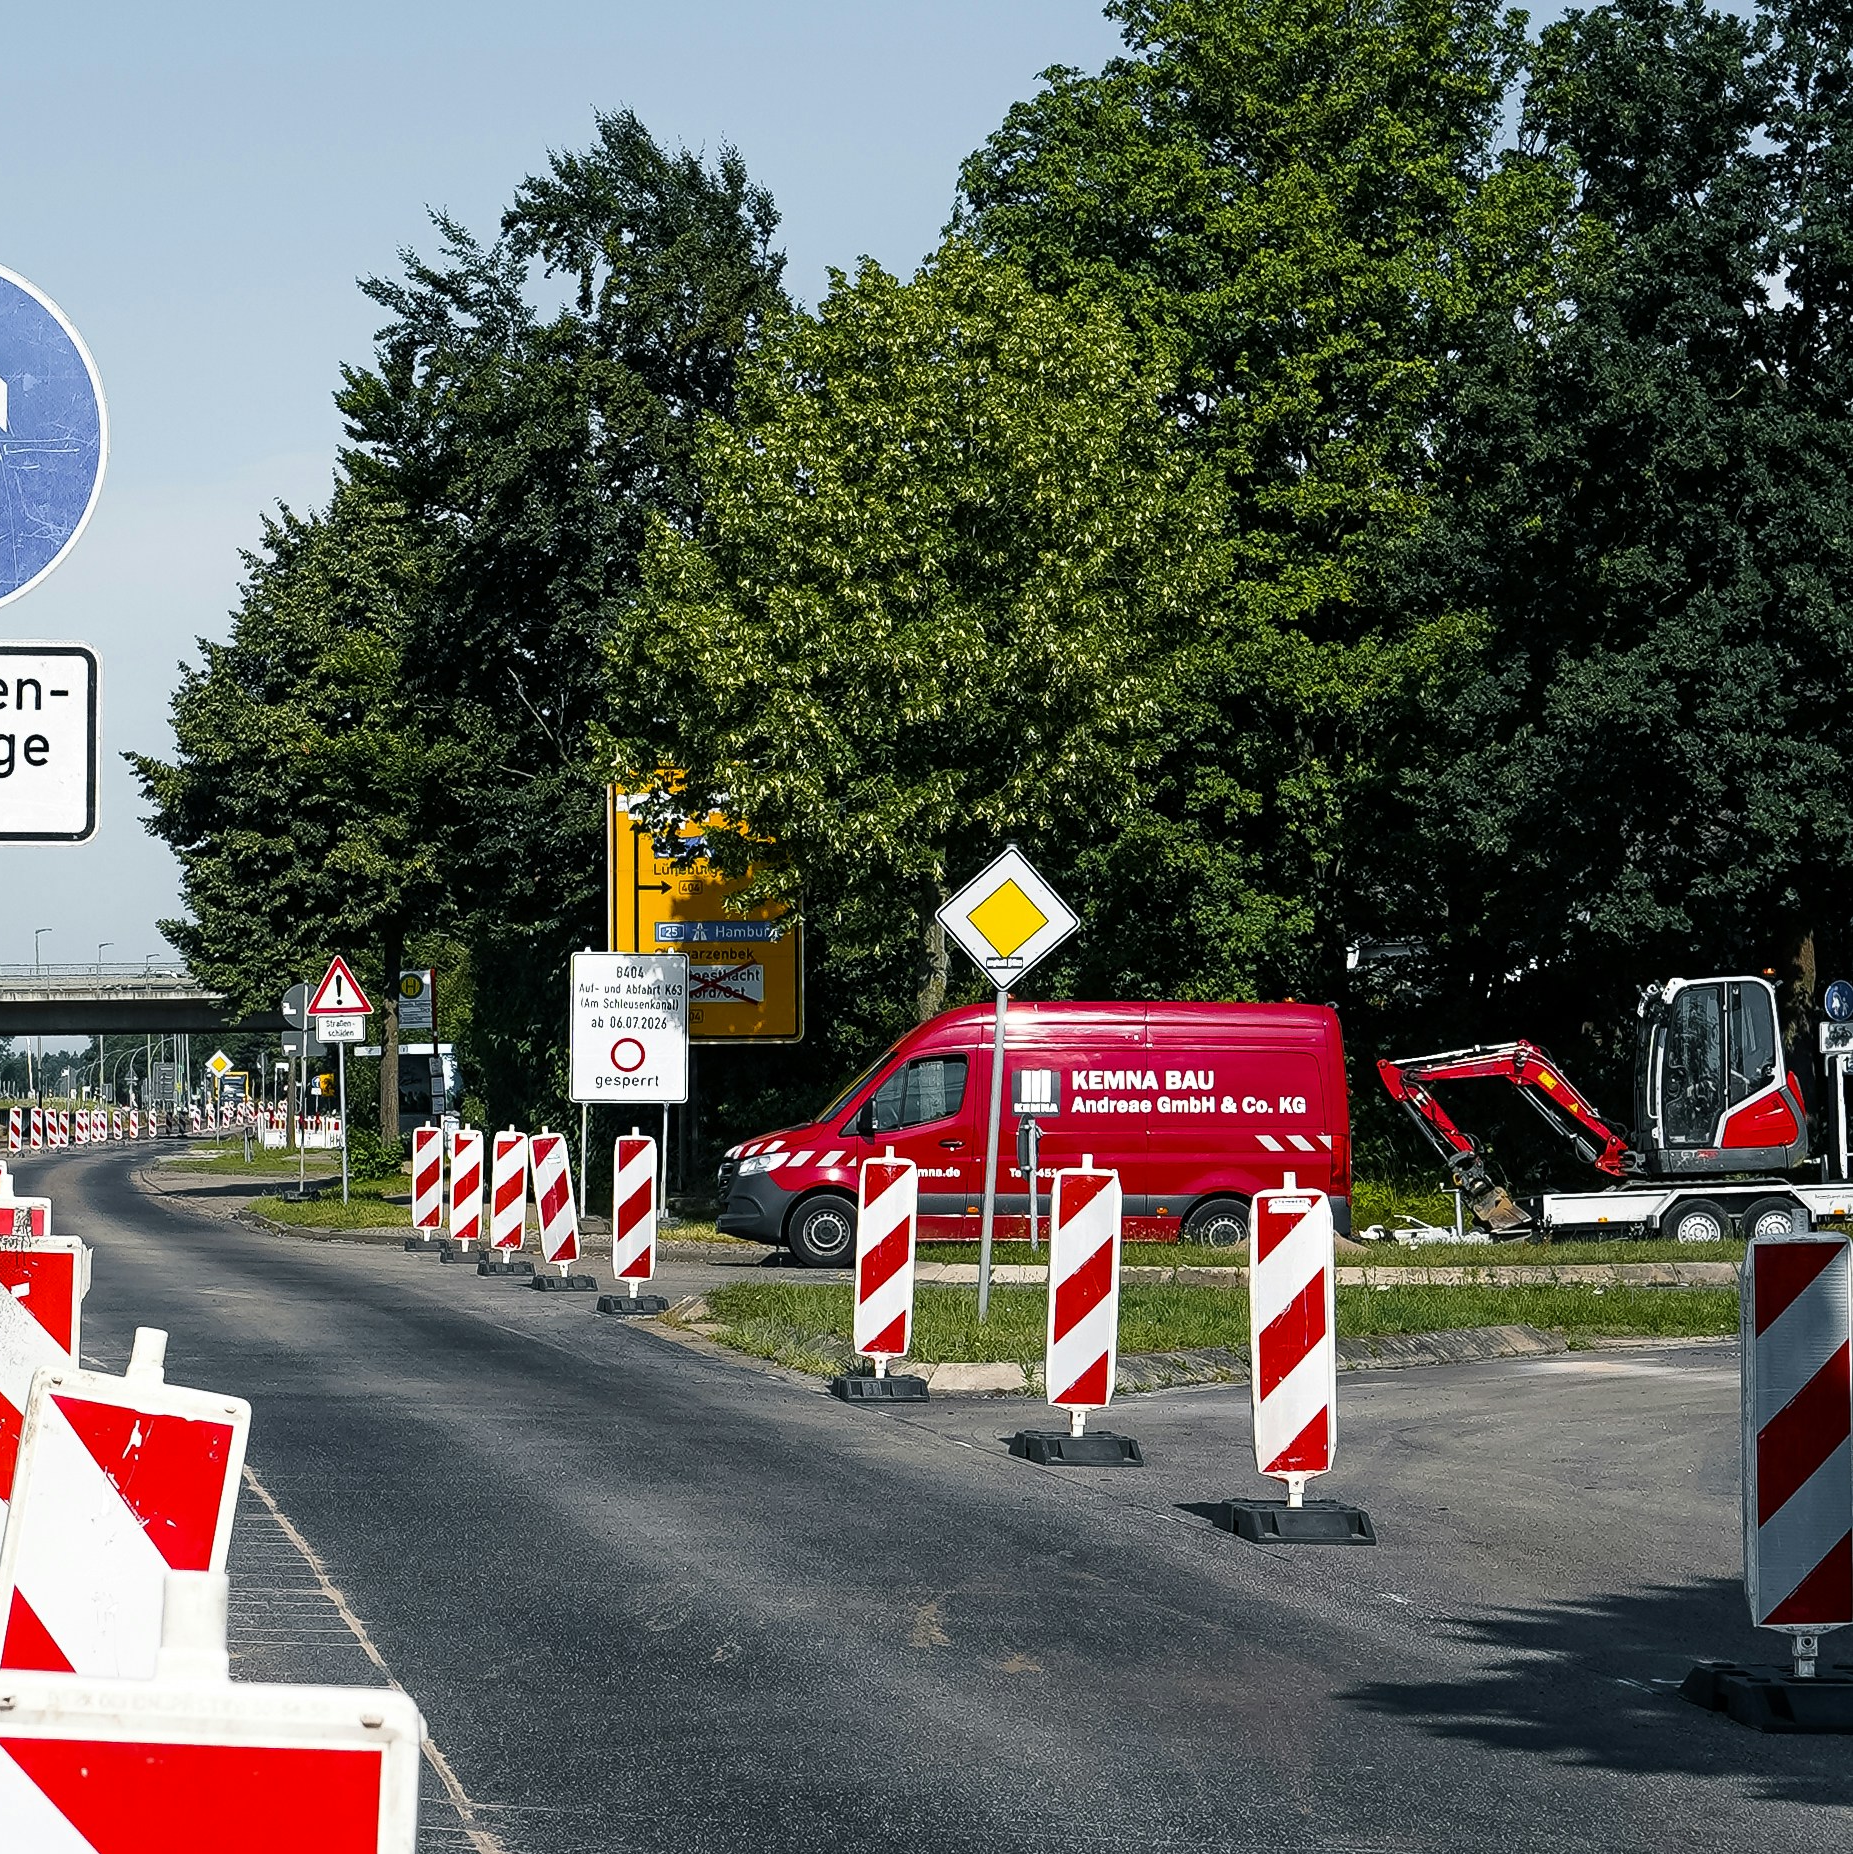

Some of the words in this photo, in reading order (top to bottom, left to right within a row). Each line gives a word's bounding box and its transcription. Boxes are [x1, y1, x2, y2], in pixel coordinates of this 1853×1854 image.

[681, 882, 700, 892] 404
[665, 926, 678, 938] 25
[715, 925, 771, 938] Hambur
[579, 983, 599, 993] Auf-
[604, 984, 621, 994] und
[626, 984, 661, 996] Abfahrt
[665, 984, 683, 996] K63
[580, 998, 599, 1009] (Am
[603, 998, 679, 1012] Schleusenkanal)
[326, 1019, 356, 1028] Straßen-
[591, 1016, 604, 1028] ab
[610, 1016, 667, 1029] 06.07.2026
[595, 1075, 659, 1088] gesperrt
[1071, 1070, 1159, 1090] KEMNA
[1165, 1070, 1215, 1090] BAU
[1013, 1102, 1059, 1113] KEMNA
[1071, 1097, 1152, 1113] Andreae
[1157, 1096, 1215, 1113] GmbH
[1220, 1096, 1238, 1113] &
[1242, 1096, 1273, 1113] Co.
[1279, 1096, 1306, 1113] KG
